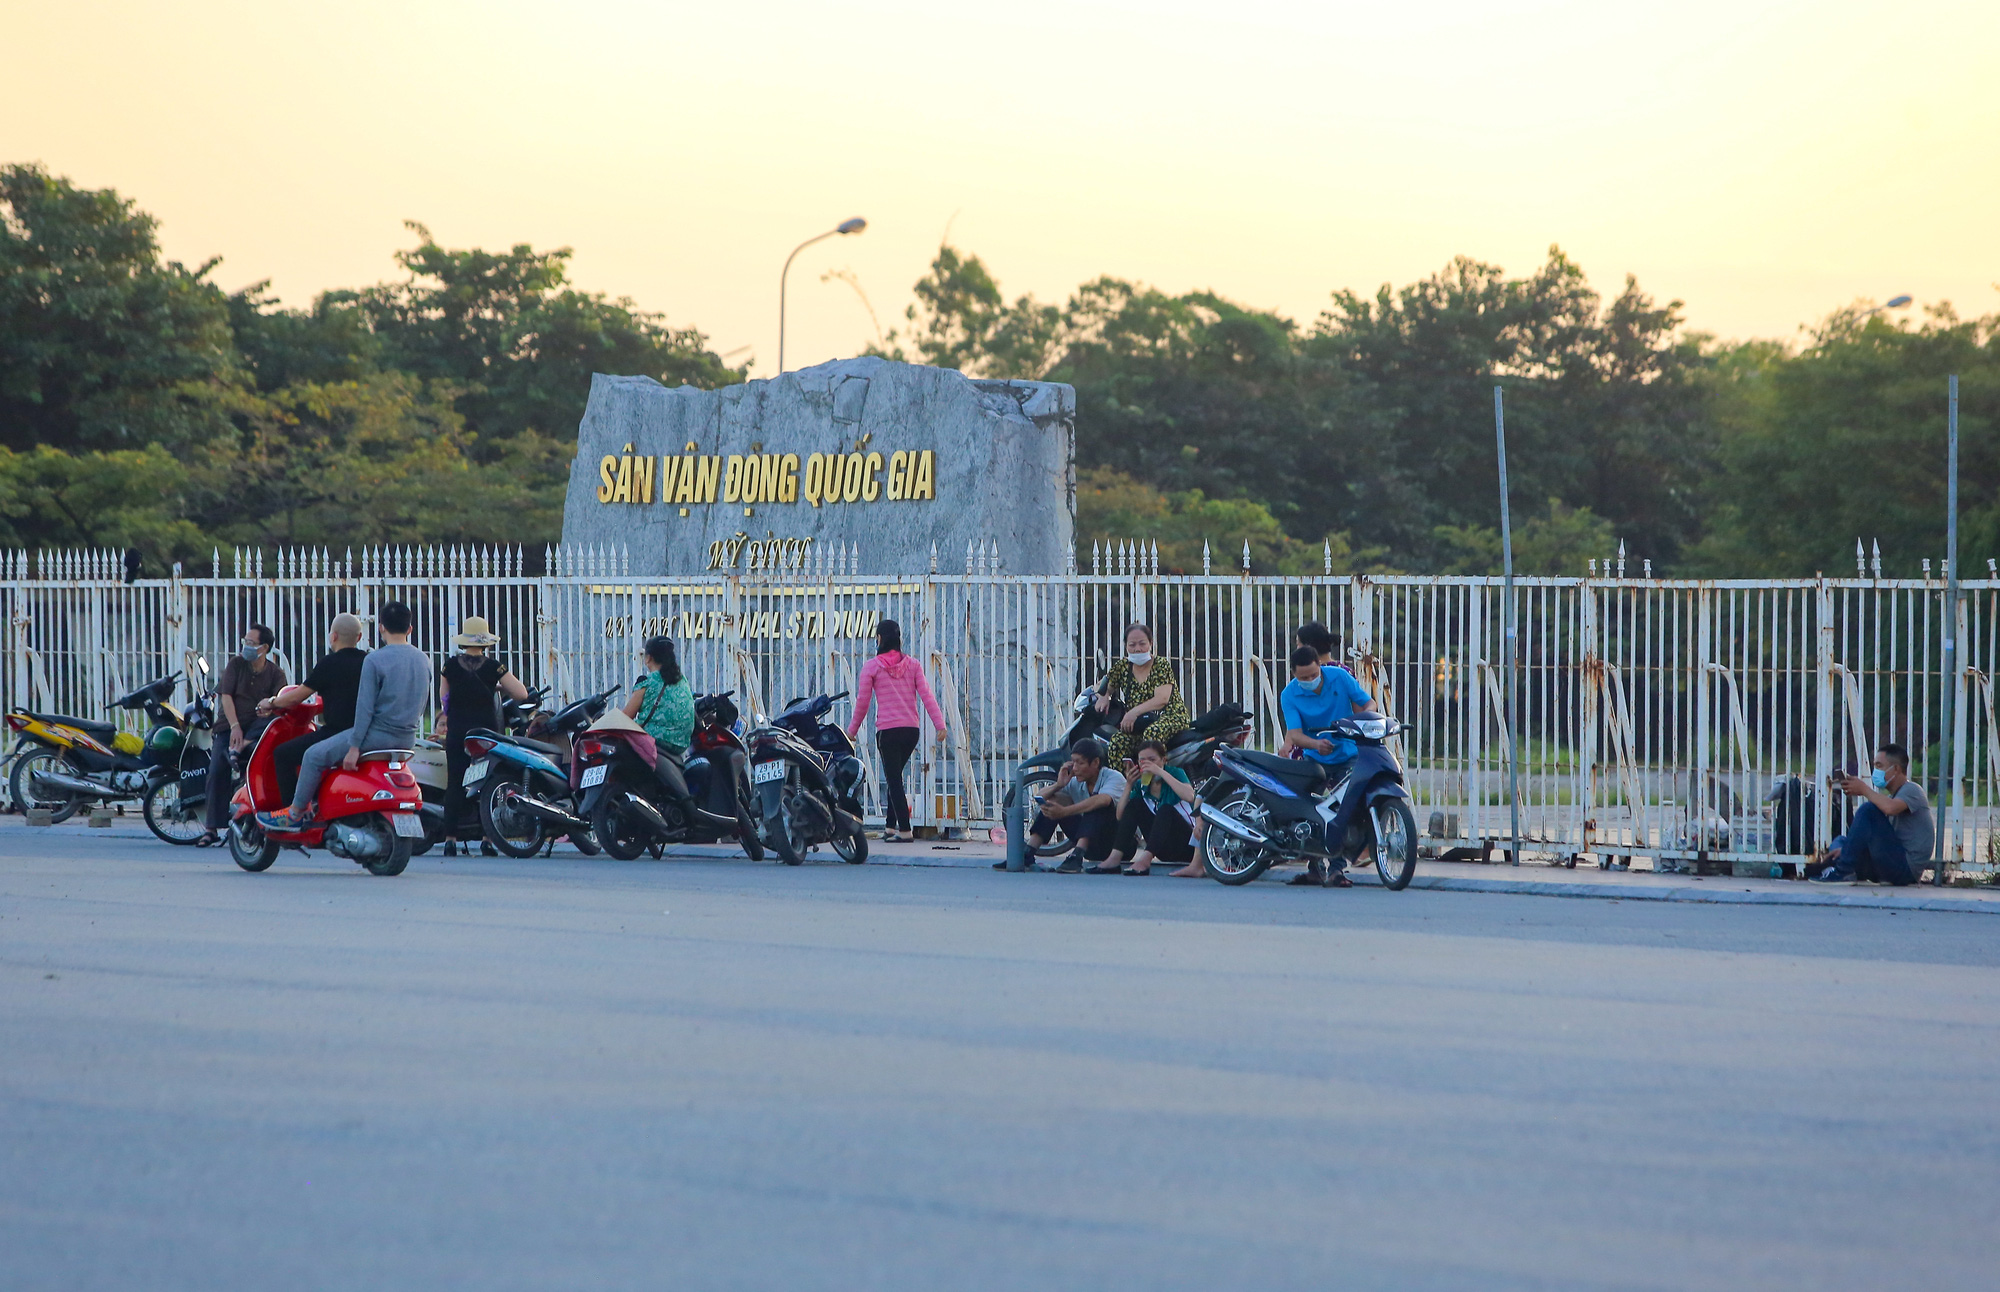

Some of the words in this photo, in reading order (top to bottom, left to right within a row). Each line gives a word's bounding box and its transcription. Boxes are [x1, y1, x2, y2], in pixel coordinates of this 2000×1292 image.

[597, 442, 656, 504] SÂN
[662, 441, 723, 517] VẬN
[723, 441, 800, 517] ĐỘNG
[804, 433, 884, 508] QUỐC
[887, 449, 935, 501] GIA
[706, 531, 748, 570] MỸ
[678, 611, 781, 639] NATINAL
[180, 767, 207, 780] Owen
